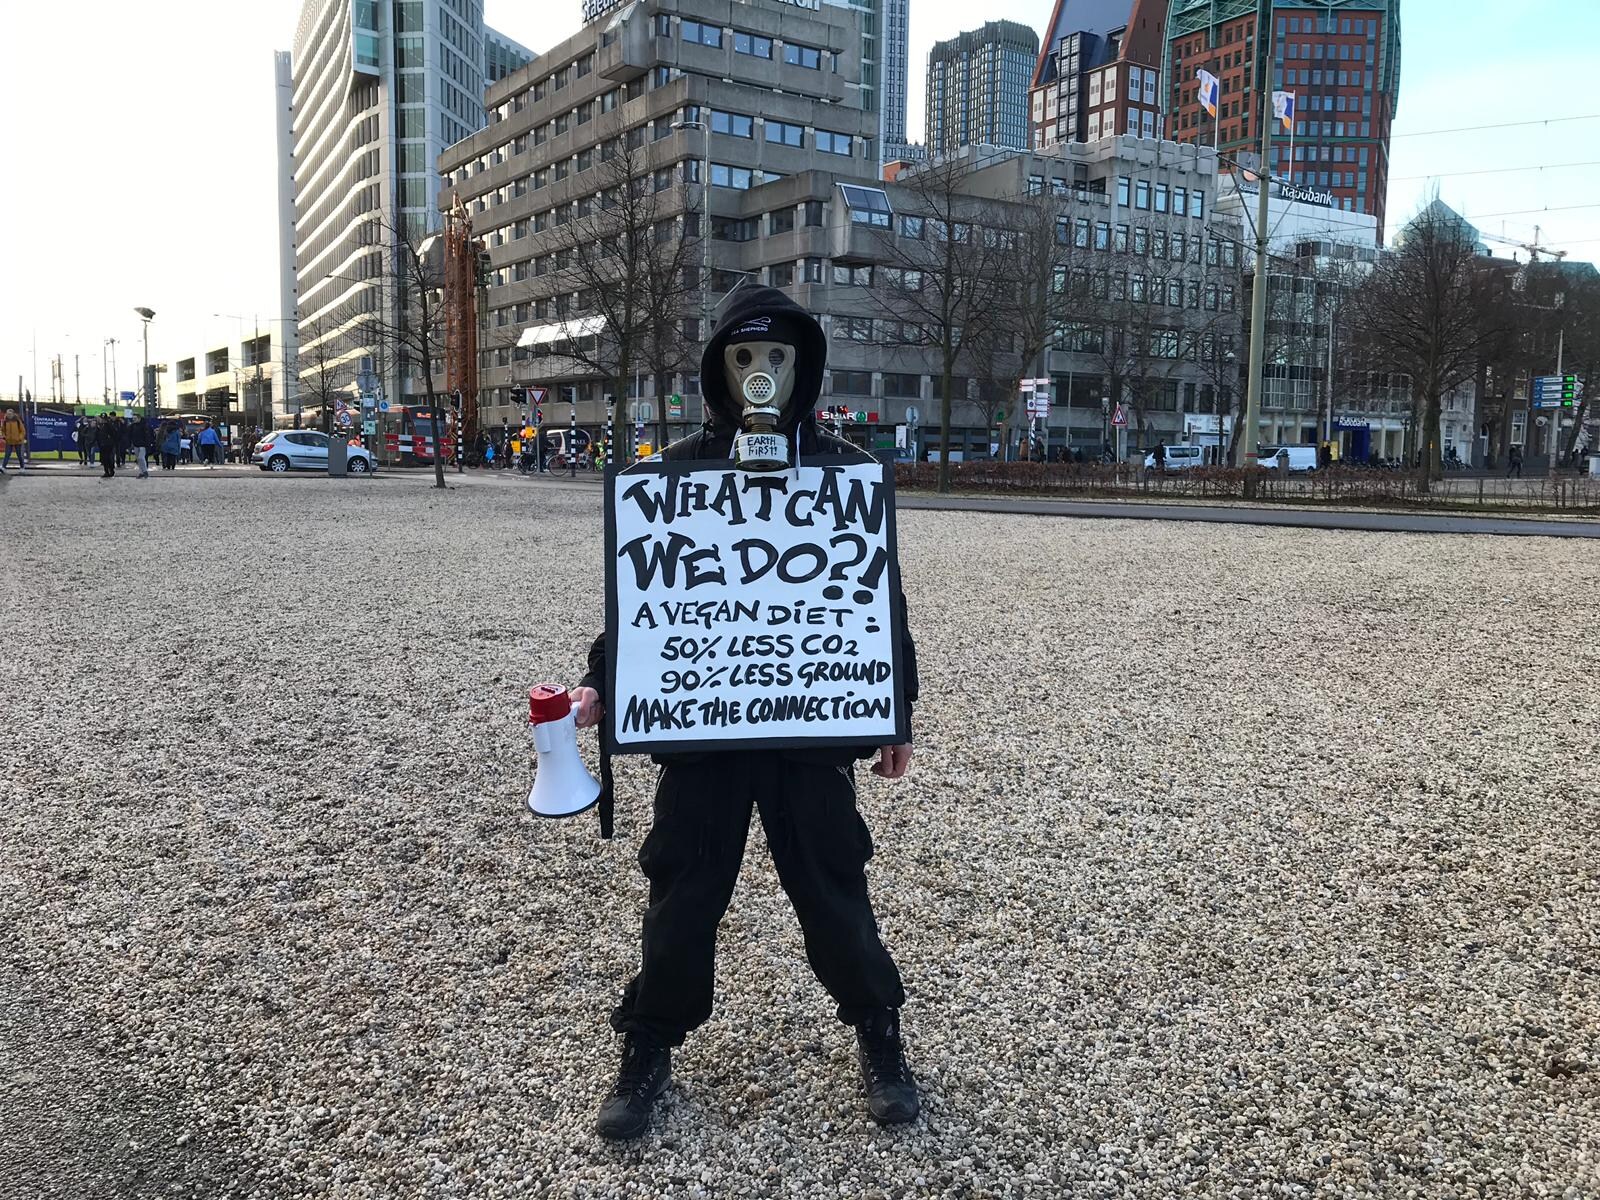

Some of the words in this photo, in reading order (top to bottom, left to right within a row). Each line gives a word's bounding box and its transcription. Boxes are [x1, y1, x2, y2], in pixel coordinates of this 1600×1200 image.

[622, 472, 789, 525] WHAT
[784, 466, 887, 534] CAN
[618, 531, 727, 591] WE
[631, 601, 658, 629] A
[659, 599, 761, 629] VEGAN
[660, 635, 723, 664] 50%
[726, 634, 794, 658] LESS
[801, 634, 860, 657] CO2
[660, 666, 729, 694] 90%
[729, 662, 794, 687] LESS
[797, 659, 891, 688] GROUND
[622, 694, 698, 734] MAKE
[698, 696, 742, 728] THE
